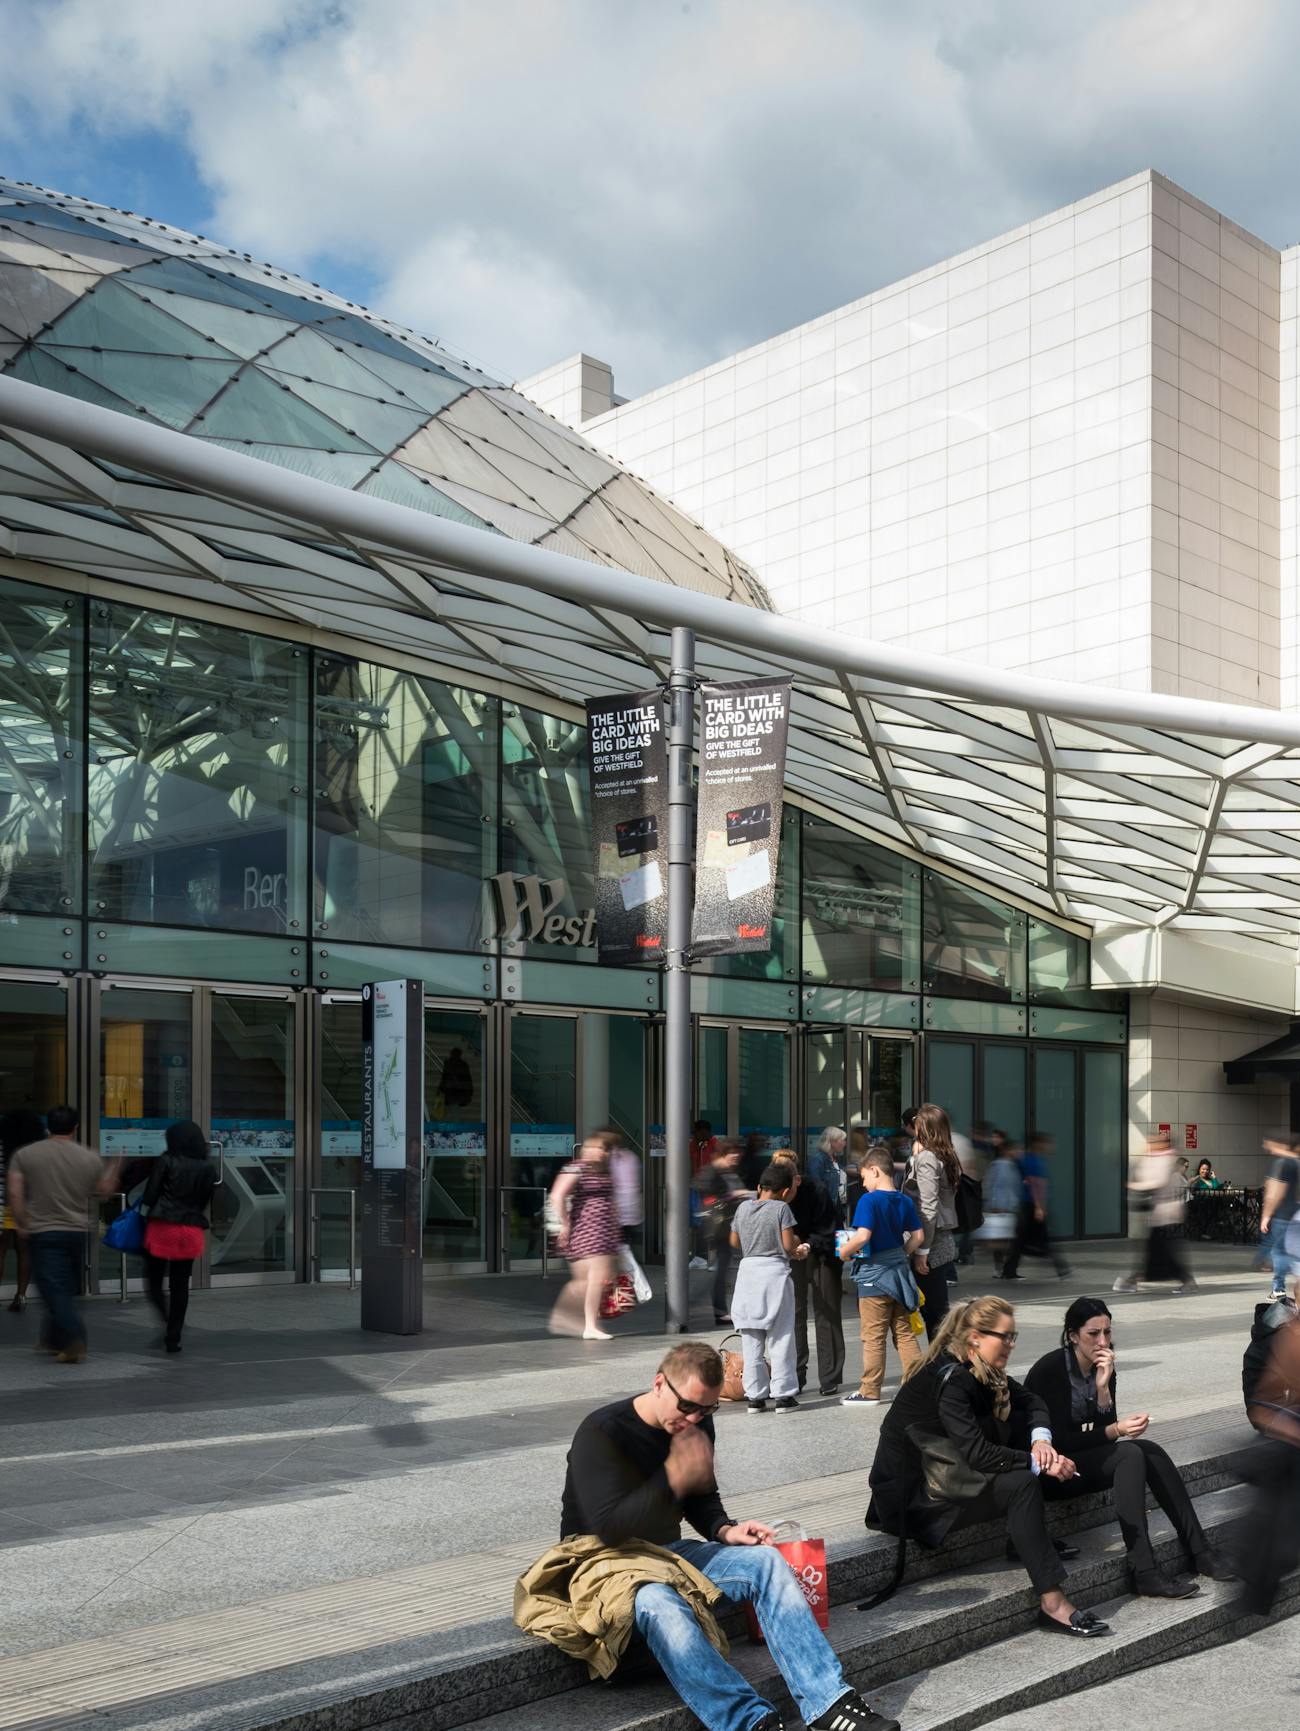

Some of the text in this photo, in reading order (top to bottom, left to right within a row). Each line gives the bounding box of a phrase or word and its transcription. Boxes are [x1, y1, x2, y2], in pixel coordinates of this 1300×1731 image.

[705, 693, 782, 712] THE LITTLE
[591, 706, 656, 727] THE LITTLE
[705, 706, 784, 726] CARD WITH
[592, 719, 660, 740] CARD WITH
[705, 721, 773, 740] BIG IDEAS
[592, 734, 652, 753] BIG IDEAS
[706, 738, 760, 750] GIVE THE GIFT
[706, 747, 762, 759] OF WESTFIELD
[593, 751, 640, 764] GIVE THE GIFT
[593, 760, 643, 773] OF WESTFIELD
[705, 767, 733, 776] Accepted
[595, 780, 619, 789] Accepted
[243, 866, 289, 911] Ber
[488, 871, 599, 946] West
[363, 1046, 373, 1164] RESTAURANTS
